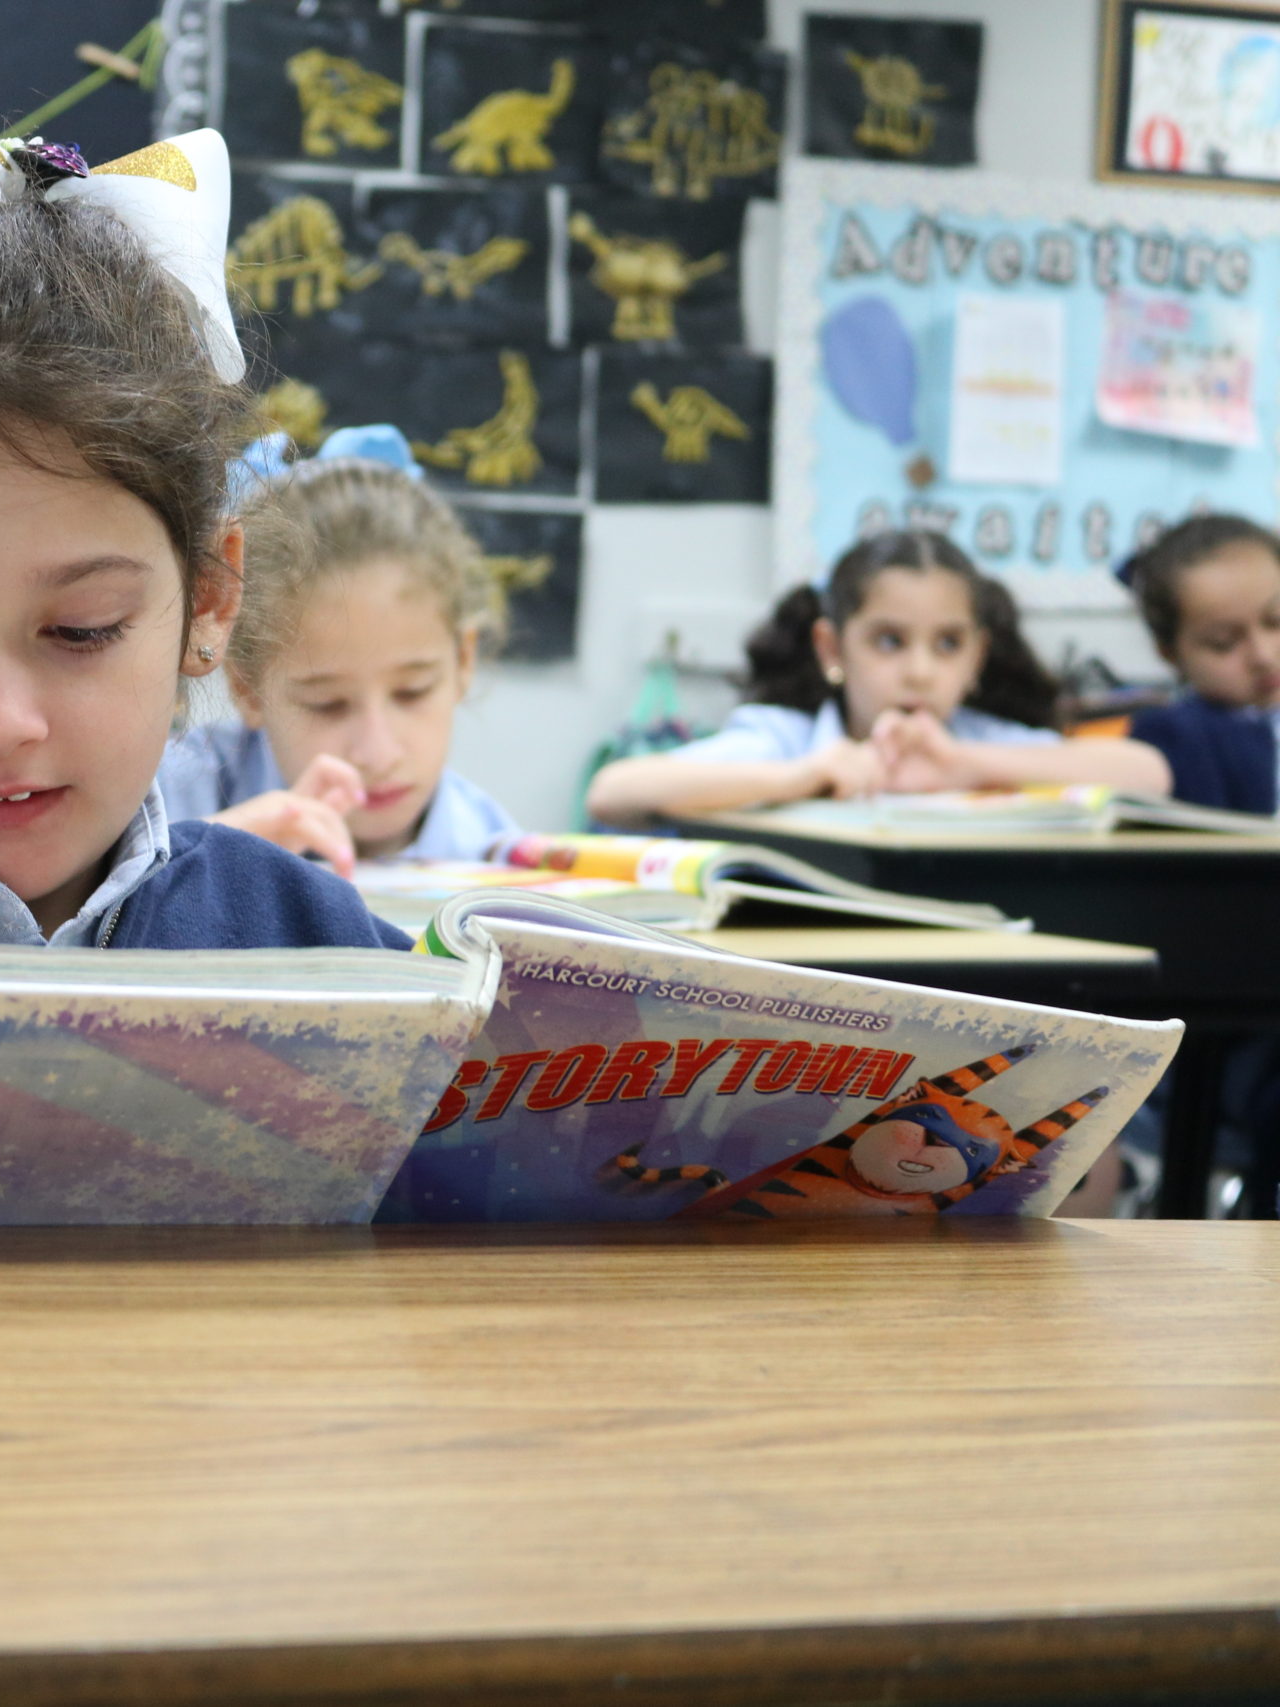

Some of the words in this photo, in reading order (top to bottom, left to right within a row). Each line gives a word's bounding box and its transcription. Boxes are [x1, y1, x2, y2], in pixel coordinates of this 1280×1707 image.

[830, 208, 1252, 297] Adventure
[520, 963, 651, 995] HARCOURT
[656, 983, 751, 1011] SCHOOL
[758, 999, 889, 1032] PUBLISHERS
[420, 1038, 917, 1135] STORYTOWN
